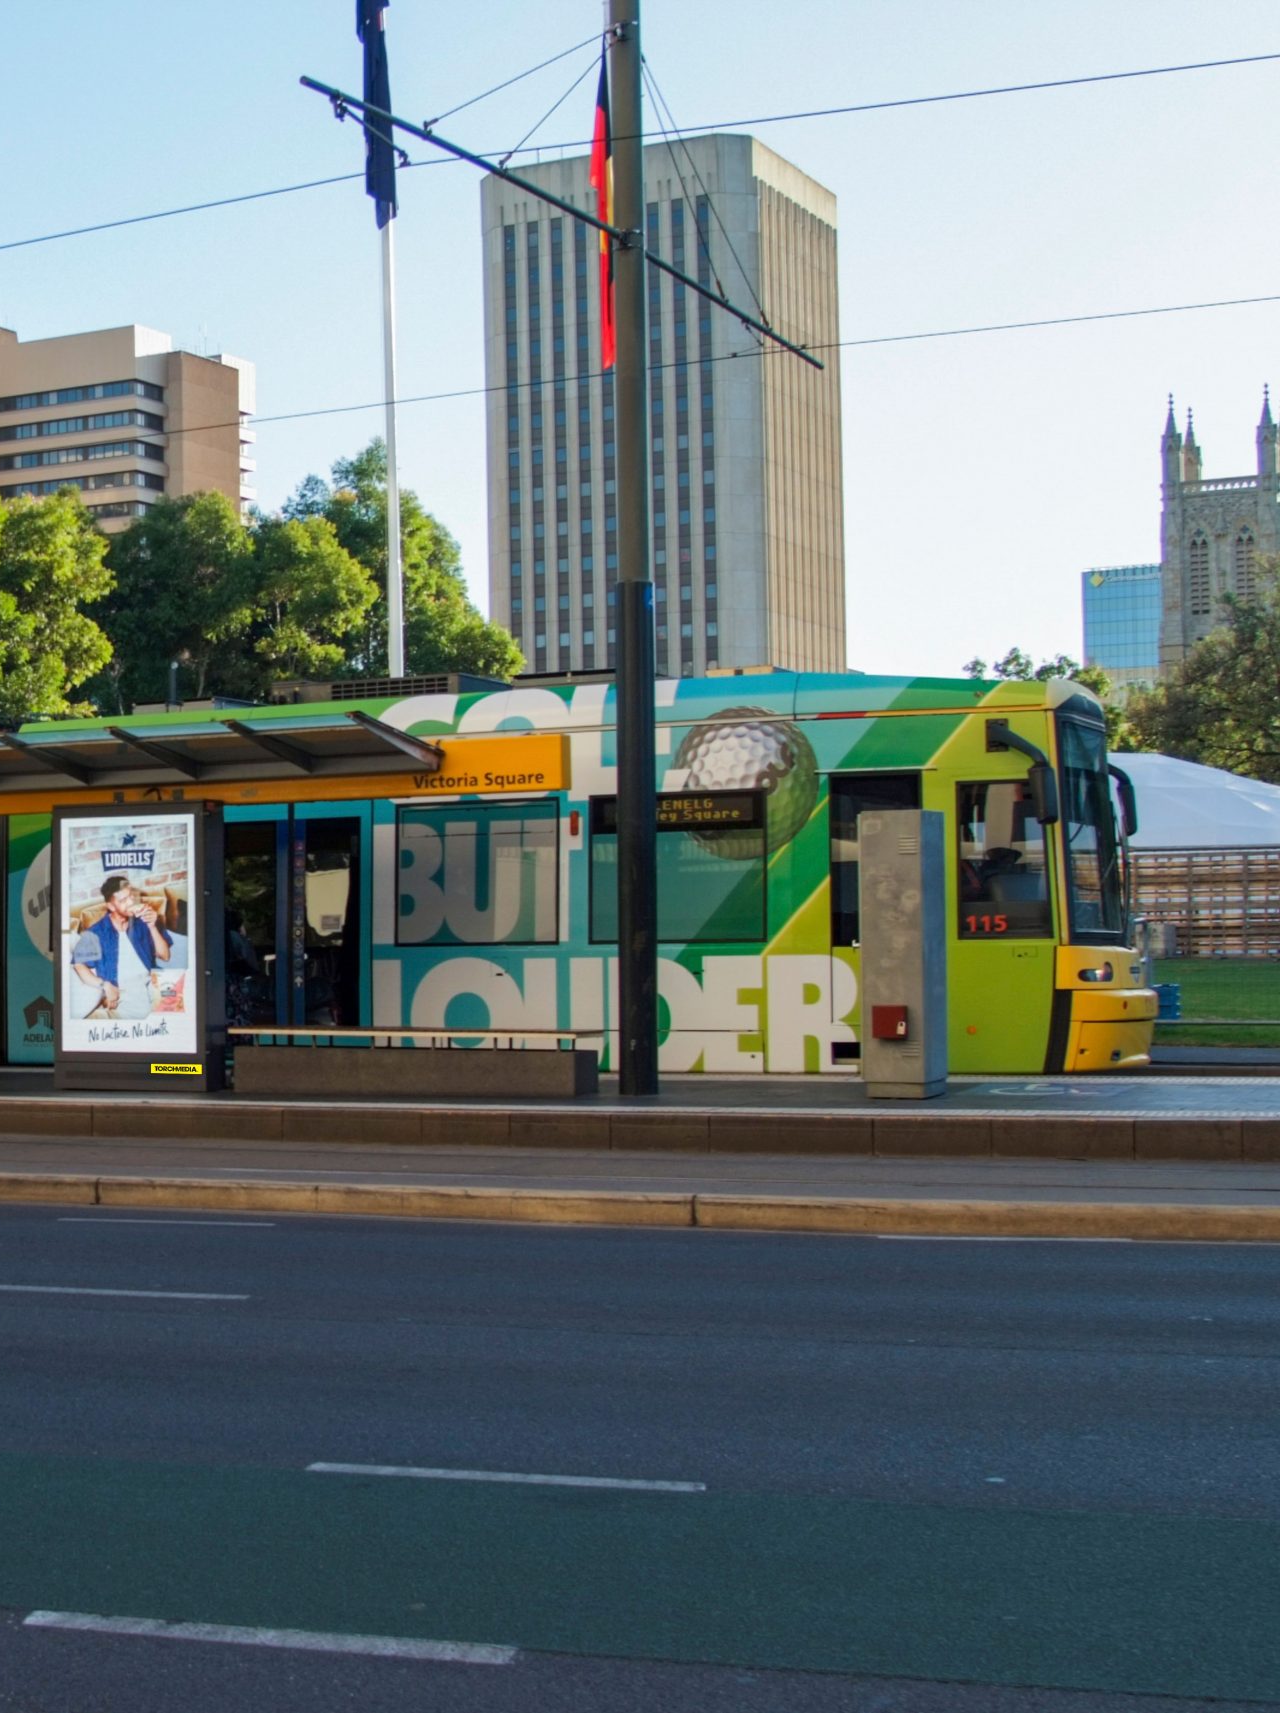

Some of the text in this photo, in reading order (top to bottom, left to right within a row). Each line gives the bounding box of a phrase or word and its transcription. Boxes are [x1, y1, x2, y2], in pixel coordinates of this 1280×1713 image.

[413, 771, 545, 789] Victoria Square
[683, 808, 741, 821] Square
[104, 852, 151, 867] LIDDELLS
[373, 817, 583, 945] BUT
[966, 914, 1008, 932] 115
